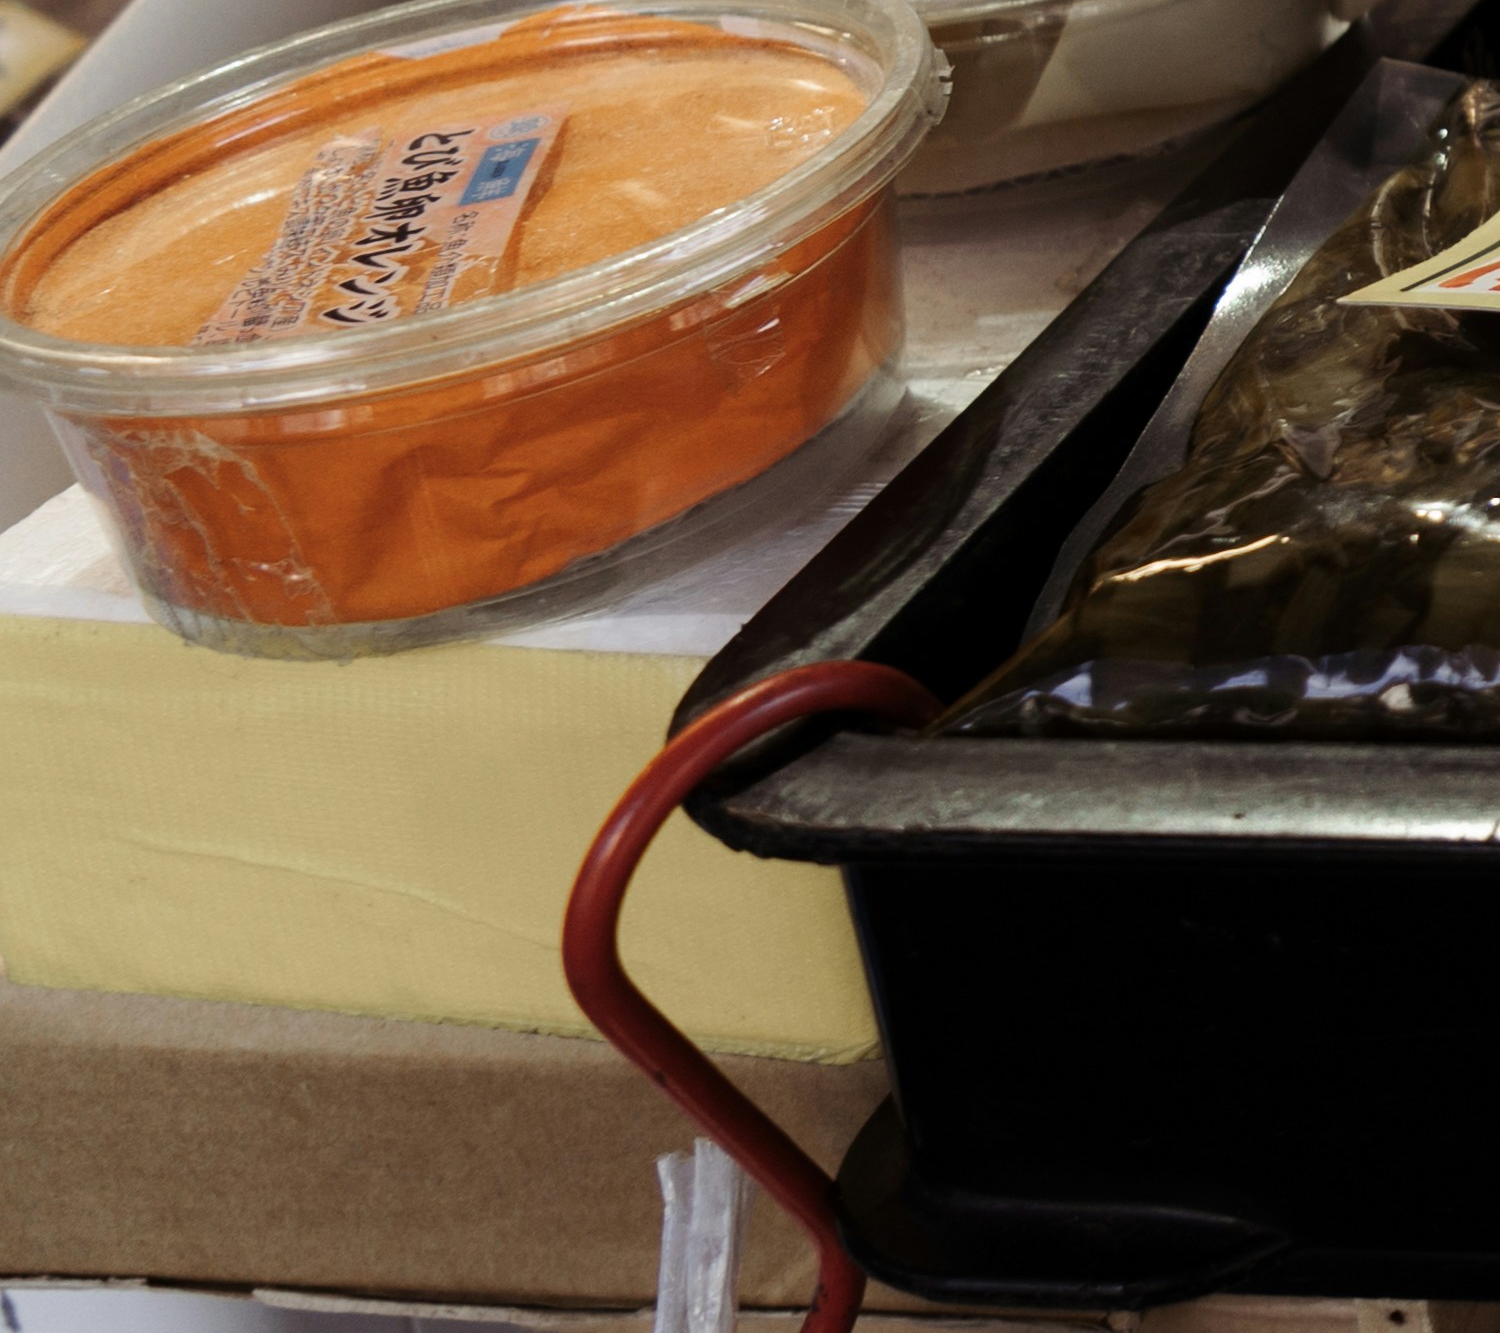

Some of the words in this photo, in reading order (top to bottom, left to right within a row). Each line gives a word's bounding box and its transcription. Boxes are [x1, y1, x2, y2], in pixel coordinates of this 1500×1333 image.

[320, 128, 476, 325] とび魚卵オレンジ
